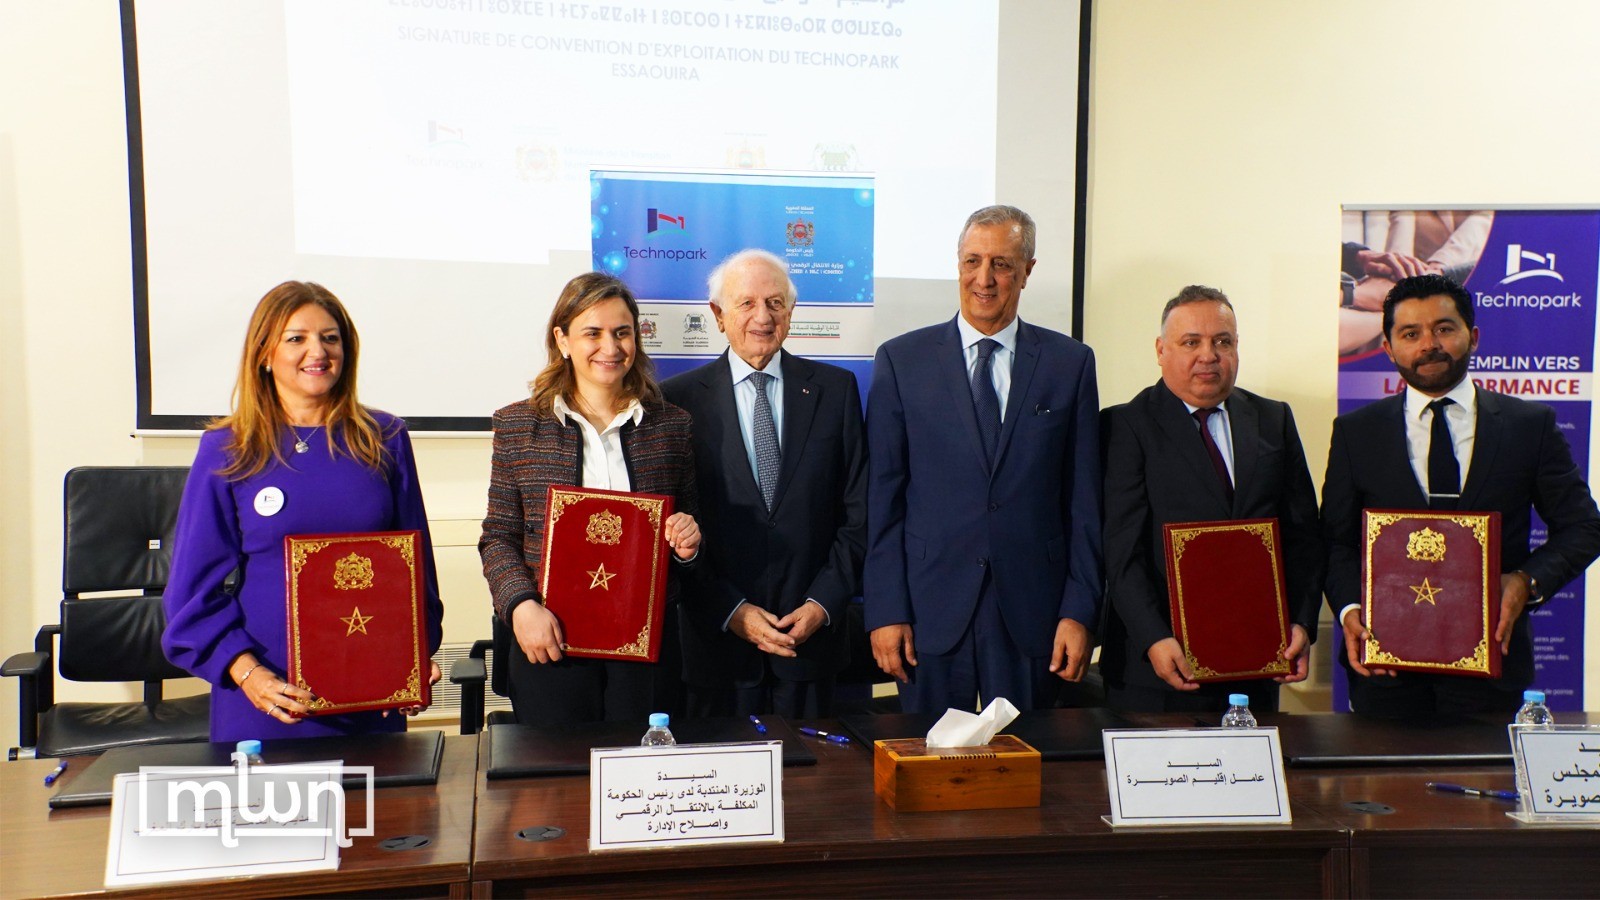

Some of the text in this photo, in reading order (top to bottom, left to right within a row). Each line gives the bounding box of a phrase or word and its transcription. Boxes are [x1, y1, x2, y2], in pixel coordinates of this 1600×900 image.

[397, 25, 901, 70] SIGNATURE DE CONVENTION D'EXPLOITATION DU TECHNOPARK
[611, 63, 701, 82] ESSAOUIRA
[623, 246, 707, 262] Technopark
[1475, 291, 1582, 311] Technopark
[1468, 355, 1581, 371] EMPLIN VERS
[1383, 378, 1580, 396] LA ORMANCE
[1166, 757, 1223, 770] السيد
[1552, 763, 1600, 782] مجلس
[657, 769, 718, 782] السيدة
[1127, 772, 1265, 787] عامل إقليم الصويرة
[607, 783, 766, 802] الوزيرة المنتدبة لدى رئيس الحكومة
[1544, 788, 1600, 808] صويرة
[615, 800, 759, 820] المكلفة بالانتقال الرقمي
[647, 819, 729, 836] وإصلاح الإدارة
